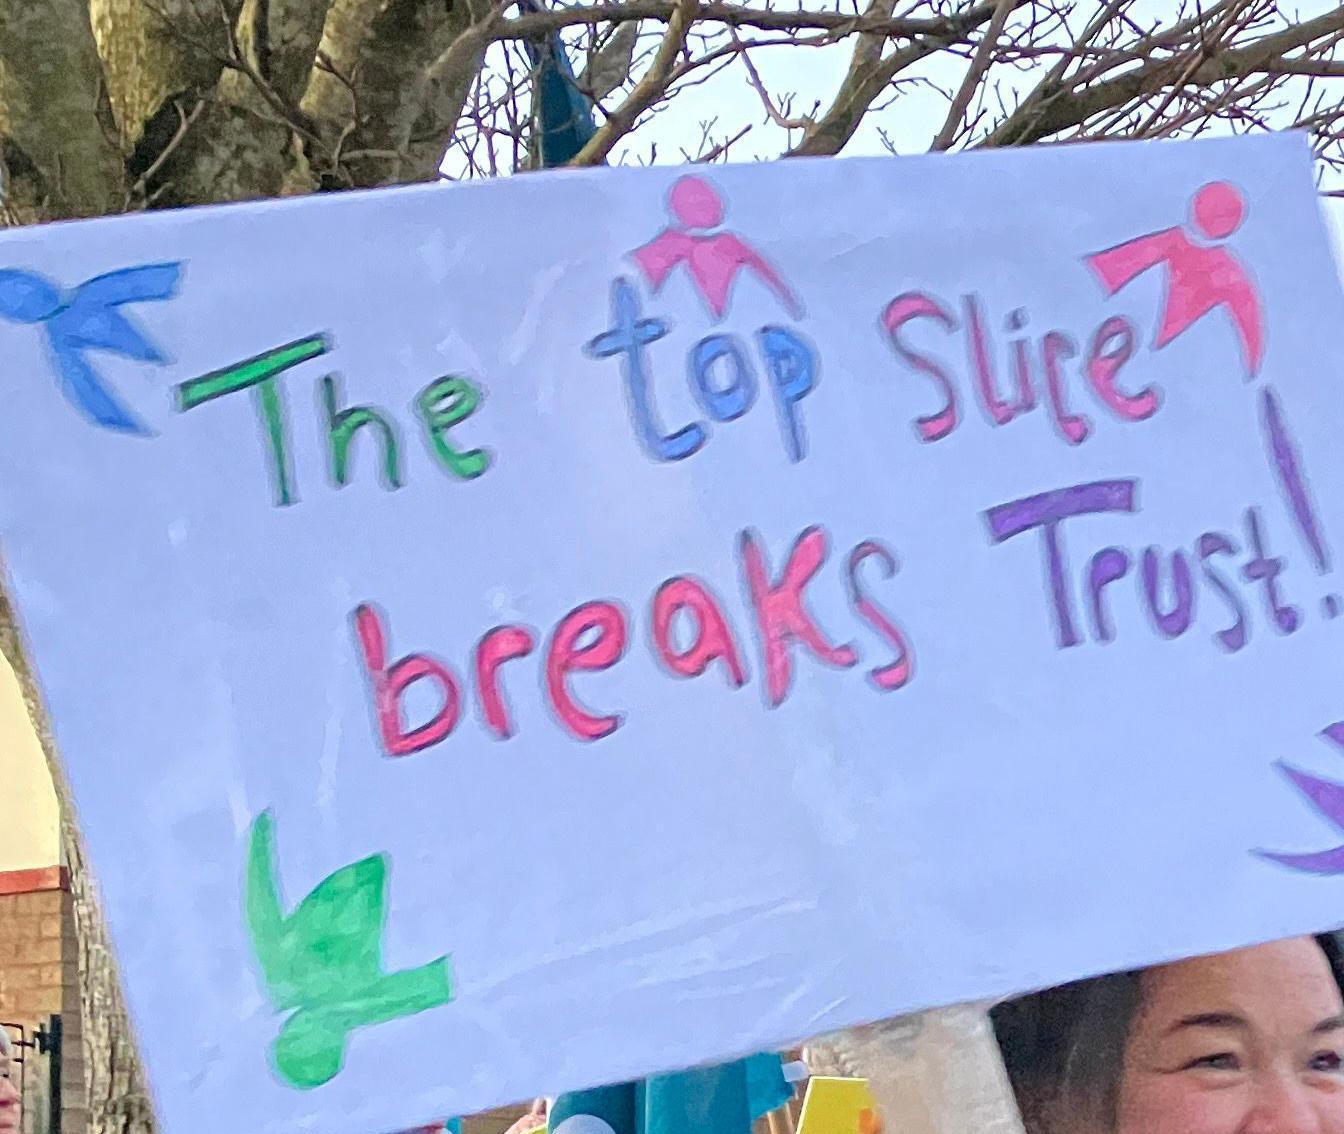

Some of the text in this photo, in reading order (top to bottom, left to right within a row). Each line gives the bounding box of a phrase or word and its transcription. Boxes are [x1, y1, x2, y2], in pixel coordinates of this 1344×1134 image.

[171, 276, 1162, 507] The top Slice
[981, 384, 1342, 653] Trust!
